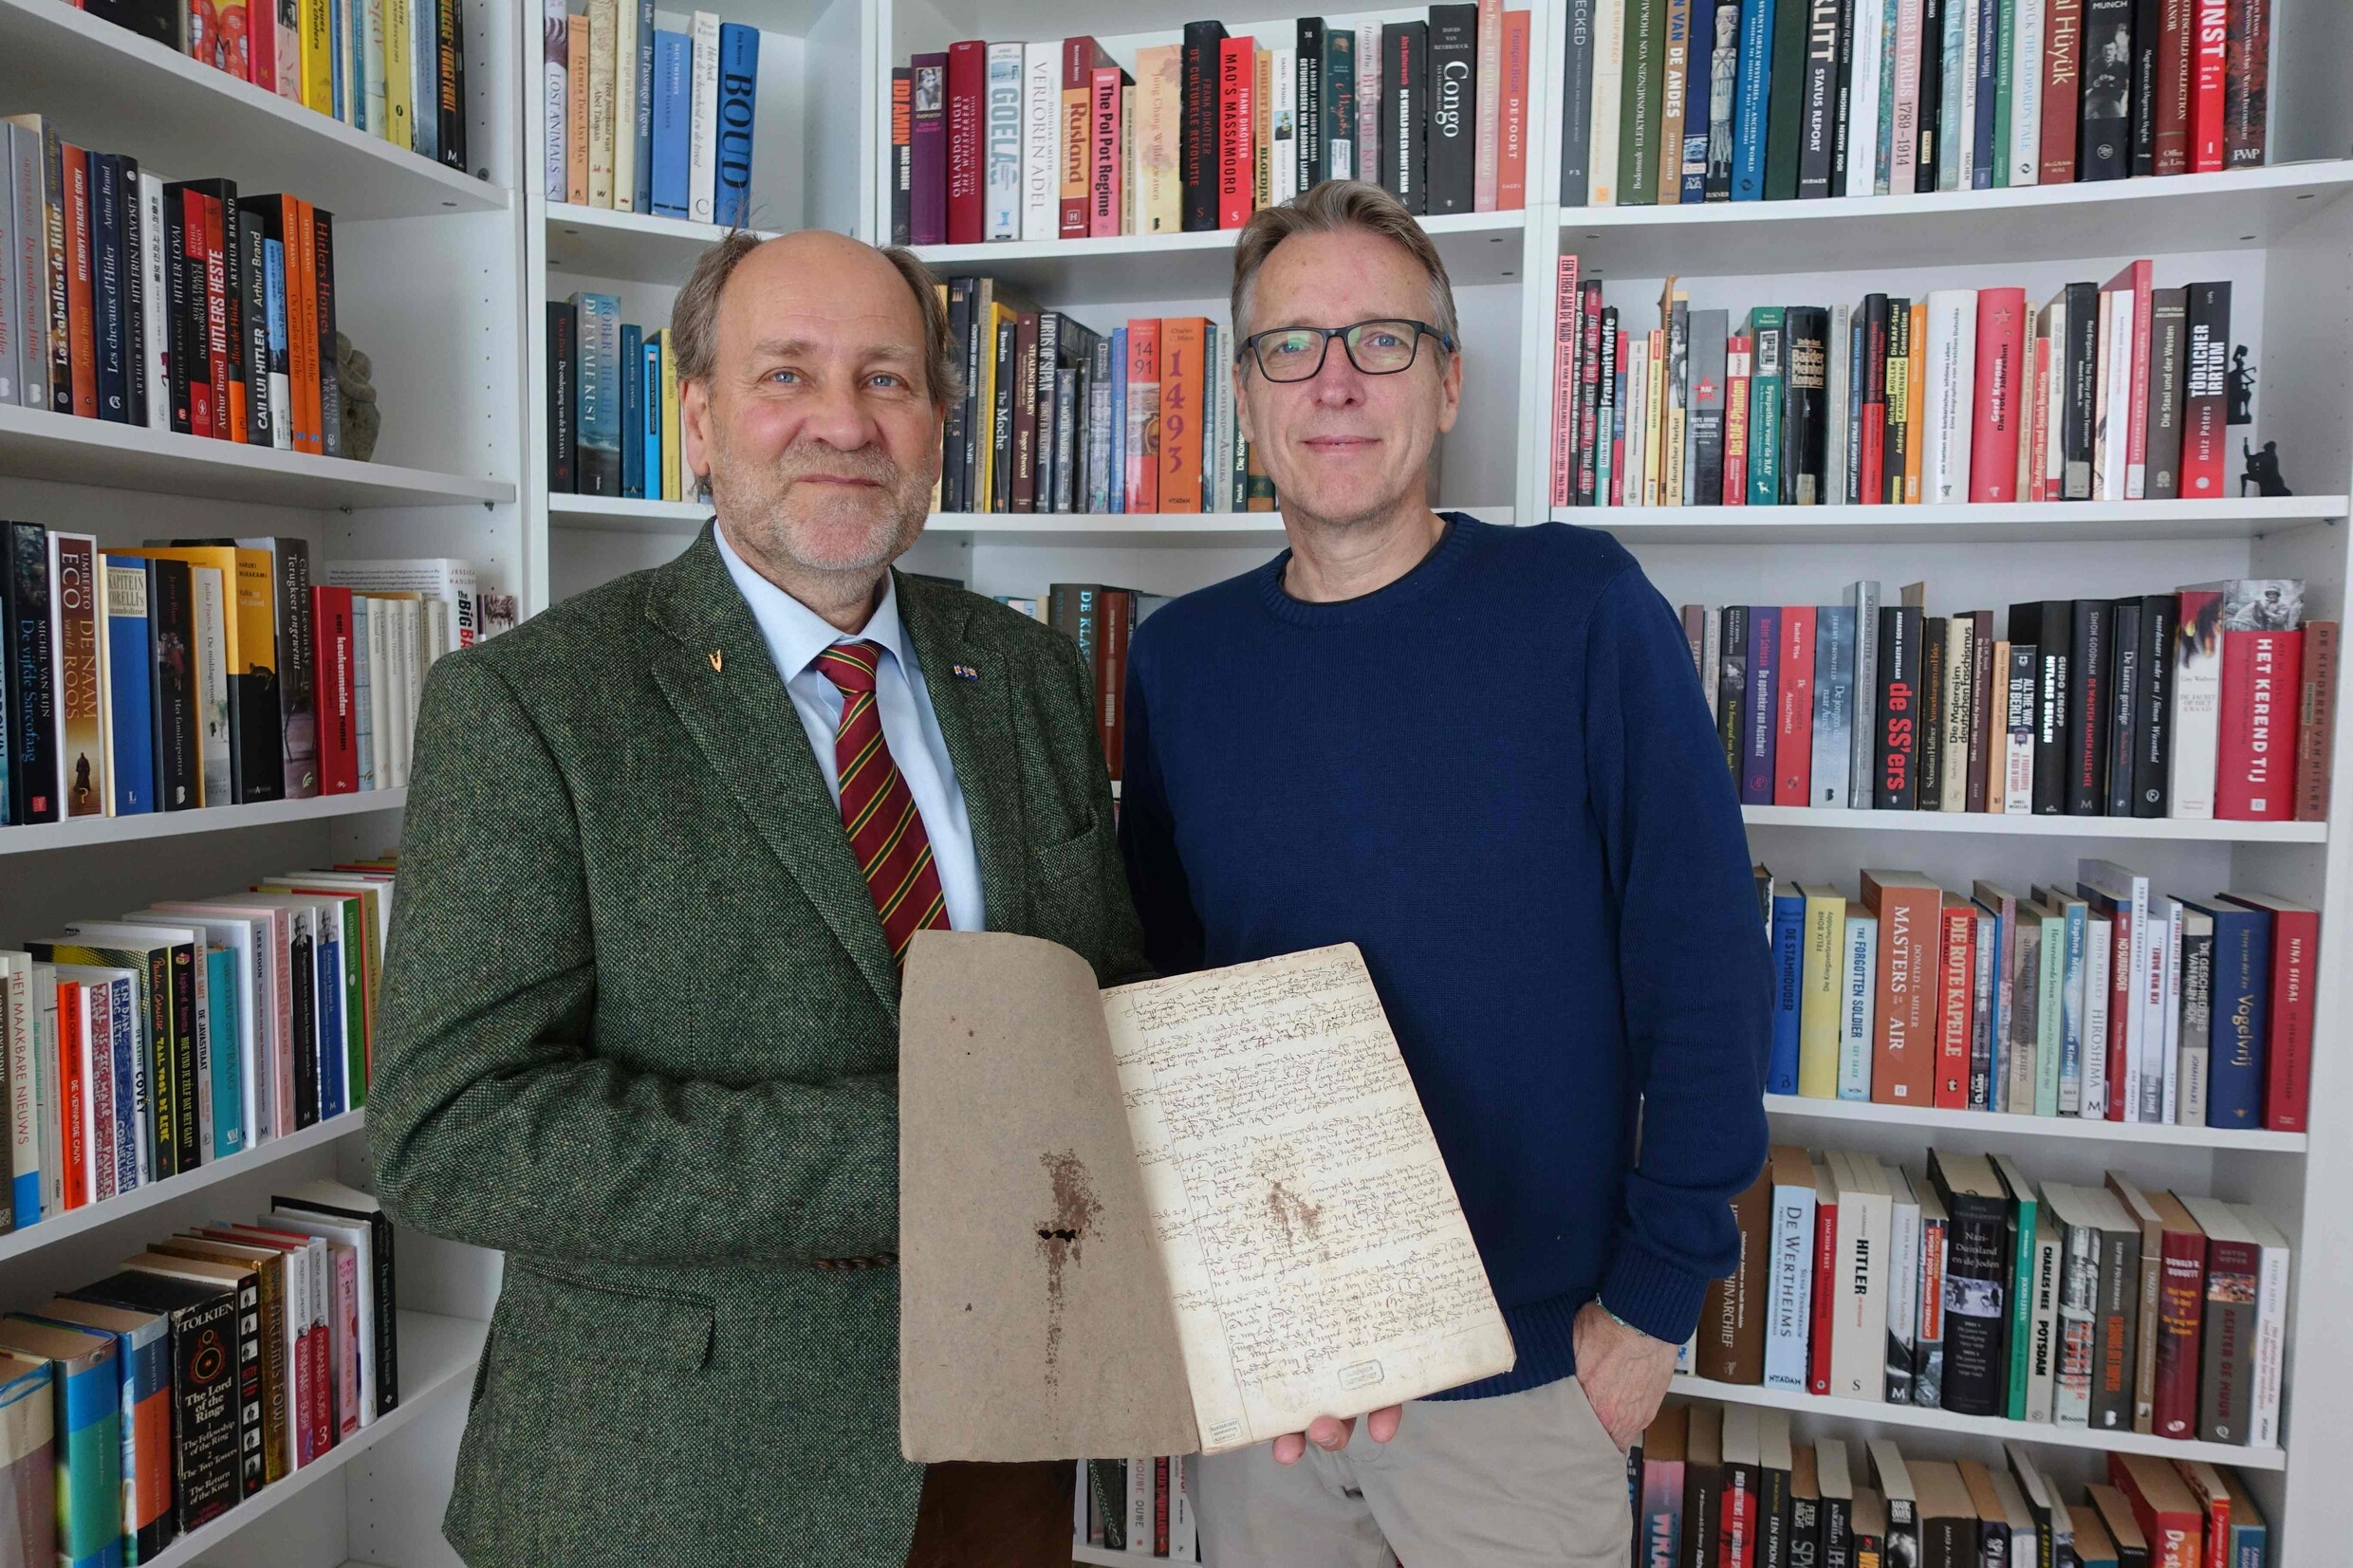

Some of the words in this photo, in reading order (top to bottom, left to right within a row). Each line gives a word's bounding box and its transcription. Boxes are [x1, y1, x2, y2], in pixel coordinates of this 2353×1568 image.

[2093, 1, 2127, 9] MUNCH
[1640, 40, 1649, 60] VON
[1669, 47, 1683, 65] DE
[2051, 16, 2076, 85] Hüyük
[549, 74, 561, 105] LOST
[639, 62, 653, 105] Passenger
[1099, 83, 1114, 104] The
[1224, 54, 1237, 96] MAO'S
[1814, 68, 1825, 107] STATUS
[2177, 59, 2188, 120] COLLECTION
[953, 96, 961, 129] FIGES
[1032, 62, 1047, 158] VERLOREN
[1435, 61, 1469, 138] Congo
[1509, 98, 1519, 114] DE
[1635, 63, 1648, 147] ELEKTRONMÜNZEN
[1666, 70, 1682, 119] ANDES
[639, 108, 649, 137] Pigeon
[722, 73, 753, 188] BOUD
[1098, 108, 1113, 127] Pol
[1810, 110, 1822, 152] REPORT
[549, 109, 561, 174] ANIMALS
[1069, 102, 1087, 183] Rusland
[1097, 131, 1113, 152] Pot
[1224, 102, 1236, 195] MASSAMOORD
[1507, 118, 1518, 158] POORT
[2020, 123, 2029, 152] TALE
[953, 135, 961, 197] ORLANDO
[1259, 147, 1269, 203] BLOEDJAS
[1031, 166, 1045, 212] ADEL
[1095, 155, 1112, 217] Regime
[51, 203, 64, 252] Hitler
[228, 198, 236, 238] BRAND
[51, 256, 66, 281] de
[230, 242, 238, 288] ARTHUR
[251, 231, 261, 268] Brand
[104, 245, 116, 294] d'Hitler
[209, 249, 224, 291] HESTE
[252, 270, 264, 308] Arthur
[52, 283, 67, 339] caballos
[106, 296, 118, 348] chevaux
[212, 292, 227, 353] HITLERS
[585, 299, 597, 318] DE
[1891, 304, 1899, 343] RAF-Stasi
[254, 328, 266, 369] HITLER
[602, 302, 612, 359] ROBERT
[1135, 342, 1154, 357] 14
[1603, 318, 1615, 353] Waffe
[1899, 311, 1908, 356] Connection
[2164, 325, 2175, 356] Westen
[56, 342, 68, 366] Los
[107, 351, 119, 374] Les
[584, 323, 596, 381] FATALE
[1028, 343, 1036, 381] STEALING
[1135, 360, 1153, 374] 91
[1602, 354, 1614, 377] mit
[1891, 345, 1899, 356] Die
[2163, 358, 2173, 373] der
[2188, 324, 2209, 397] TÖDLICHER
[2208, 341, 2225, 396] IRRTUM
[256, 371, 268, 396] LUI
[998, 390, 1008, 406] The
[1027, 382, 1035, 416] HISTORY
[1601, 379, 1613, 406] Frau
[1898, 361, 1906, 421] KANONENBERG
[2163, 374, 2173, 390] und
[257, 397, 269, 430] CAII
[584, 383, 596, 425] KUST
[1730, 380, 1746, 439] RAF-Phantom
[2160, 413, 2171, 428] Die
[2161, 392, 2172, 412] Stasi
[2200, 406, 2212, 435] Peters
[996, 408, 1008, 451] Moche
[1729, 440, 1743, 455] Das
[1896, 423, 1905, 453] Andreas
[2198, 438, 2210, 461] Butz
[62, 552, 81, 609] ECO
[81, 553, 92, 610] UMBERTO
[287, 554, 298, 613] Terugkeer
[21, 619, 35, 642] De
[38, 619, 47, 662] MICHEL
[65, 619, 74, 637] van
[65, 639, 76, 650] de
[80, 620, 93, 649] DE
[291, 615, 302, 670] ongewenst
[1954, 666, 1961, 682] im
[1962, 627, 1973, 687] Faschismus
[2124, 651, 2134, 664] De
[2256, 638, 2272, 673] HET
[40, 667, 49, 688] VAN
[64, 655, 81, 720] ROOS
[82, 655, 97, 719] NAAM
[2010, 678, 2021, 692] TO
[2045, 655, 2056, 700] HITLERS
[2122, 666, 2134, 693] laatste
[1889, 683, 1912, 711] de
[1951, 684, 1960, 727] Malerei
[2009, 693, 2021, 726] BERLIN
[2119, 694, 2130, 725] getuige
[22, 690, 40, 763] Sarcofaag
[1961, 689, 1971, 744] deutschen
[2043, 702, 2054, 743] BEULEN
[2251, 679, 2271, 754] KEREND
[1950, 728, 1958, 744] Die
[2248, 757, 2266, 784] TIJ
[1787, 928, 1797, 942] DE
[1857, 927, 1865, 939] THE
[1950, 916, 1969, 943] DIE
[1854, 941, 1866, 996] FORGOTTEN
[1892, 906, 1910, 994] MASTERS
[1948, 948, 1967, 986] ROTE
[2290, 938, 2302, 963] NINA
[13, 971, 24, 997] HET
[1782, 945, 1796, 1012] STAMHOUDER
[2287, 967, 2300, 1003] SIEGAL
[198, 1009, 205, 1021] DE
[1852, 997, 1864, 1039] SOLDIER
[1888, 1017, 1905, 1051] AIR
[1945, 988, 1965, 1058] KAPELLE
[2231, 994, 2254, 1067] Vogelvrij
[13, 1003, 28, 1081] MAAKBARE
[198, 1023, 208, 1070] JAVASTRAAT
[2089, 1009, 2104, 1088] HIROSHIMA
[135, 1070, 146, 1114] COVEY
[16, 1085, 29, 1145] NIEUWS
[1787, 1207, 1802, 1229] DE
[1955, 1244, 1998, 1257] Duitsland
[1965, 1232, 1990, 1244] Nazi-
[1854, 1239, 1869, 1296] HITLER
[1966, 1255, 1976, 1264] de
[1977, 1257, 2000, 1269] Joden
[2042, 1246, 2052, 1285] CHARLES
[1780, 1236, 1802, 1337] WERTHEIMS
[2041, 1287, 2050, 1310] MEE
[178, 1301, 235, 1334] TOLKIEN
[2035, 1320, 2048, 1376] POTSDAM
[185, 1391, 206, 1406] The
[208, 1377, 232, 1399] Lord
[195, 1402, 207, 1413] of
[208, 1393, 225, 1409] the
[196, 1404, 225, 1424] Rings
